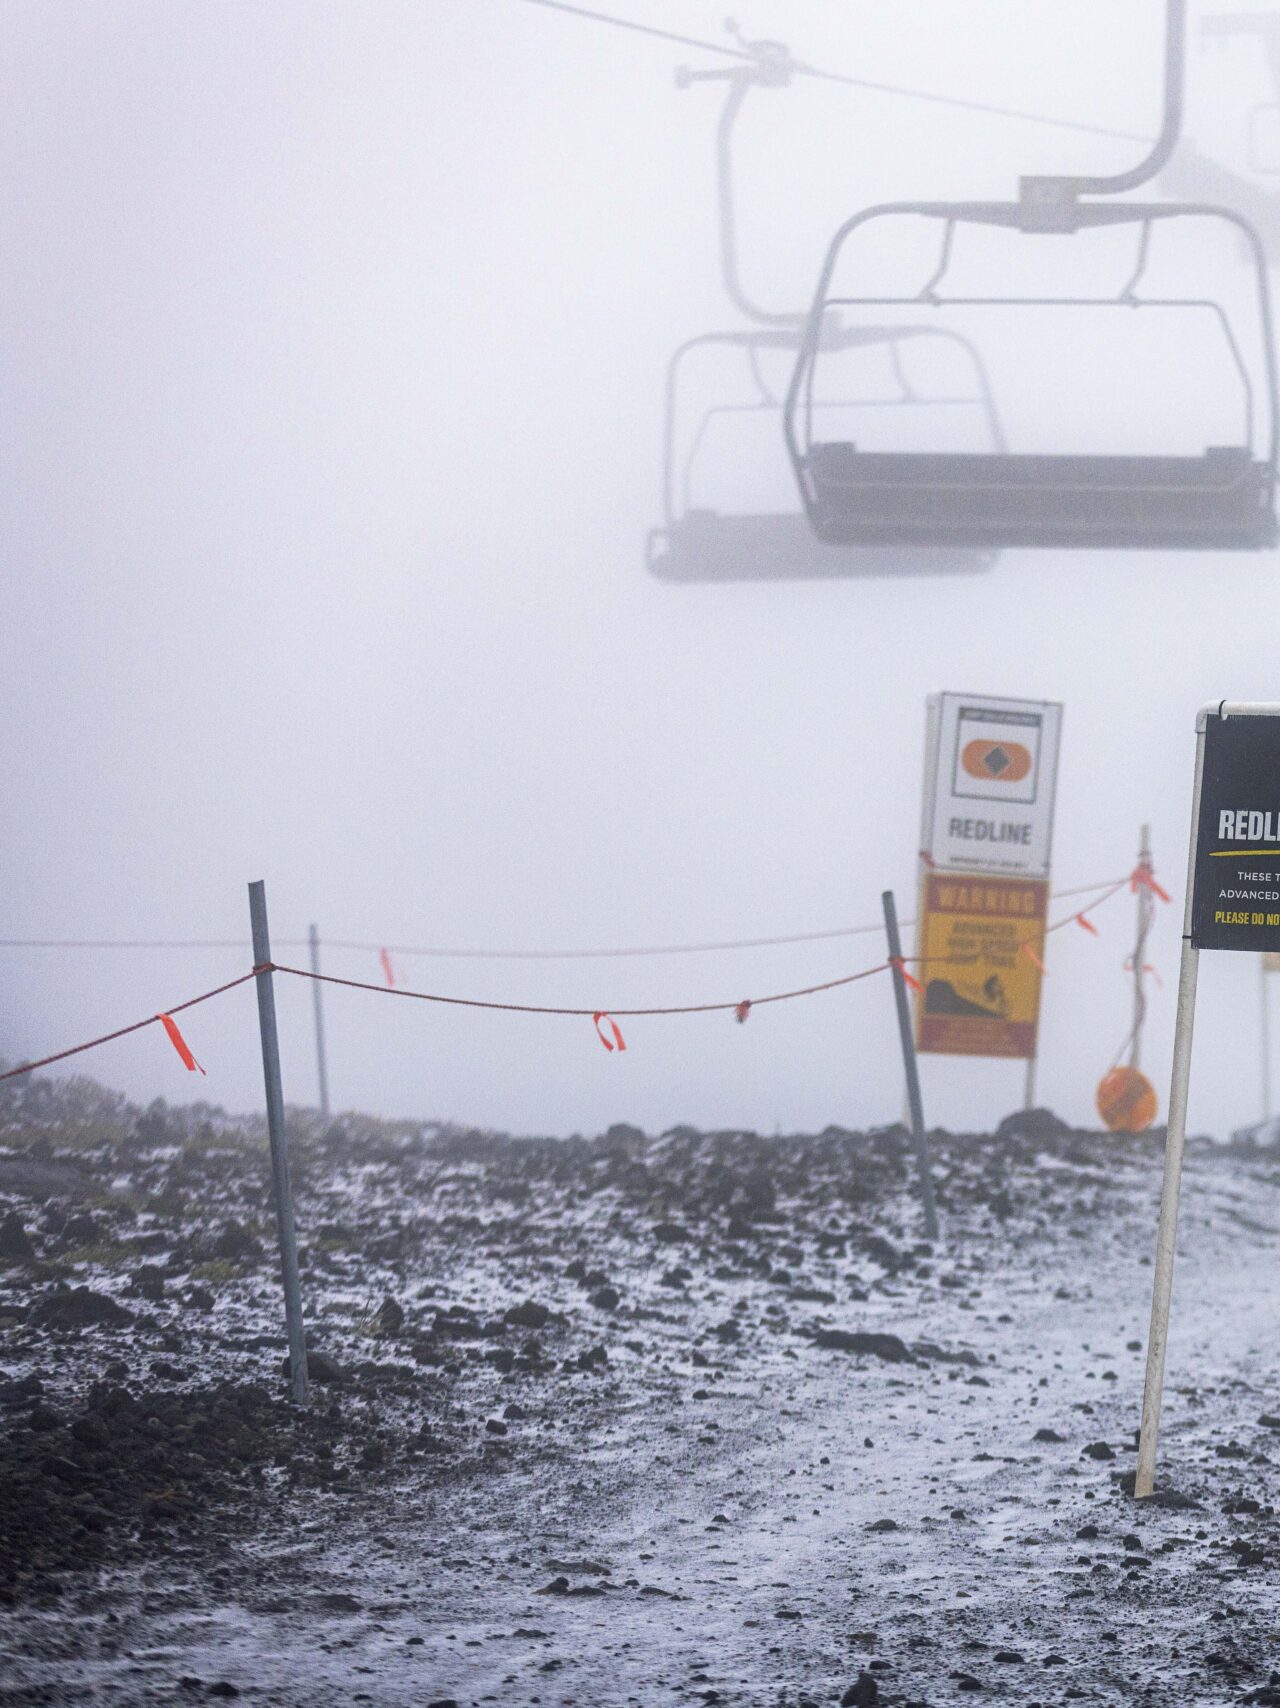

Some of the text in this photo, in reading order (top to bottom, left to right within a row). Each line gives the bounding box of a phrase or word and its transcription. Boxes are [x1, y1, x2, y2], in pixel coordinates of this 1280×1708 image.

[949, 817, 1033, 845] REDLINE
[1238, 871, 1272, 881] THESE
[1219, 889, 1279, 900] ADVANCED
[1215, 911, 1249, 924] PLEASE
[1252, 913, 1264, 925] DO
